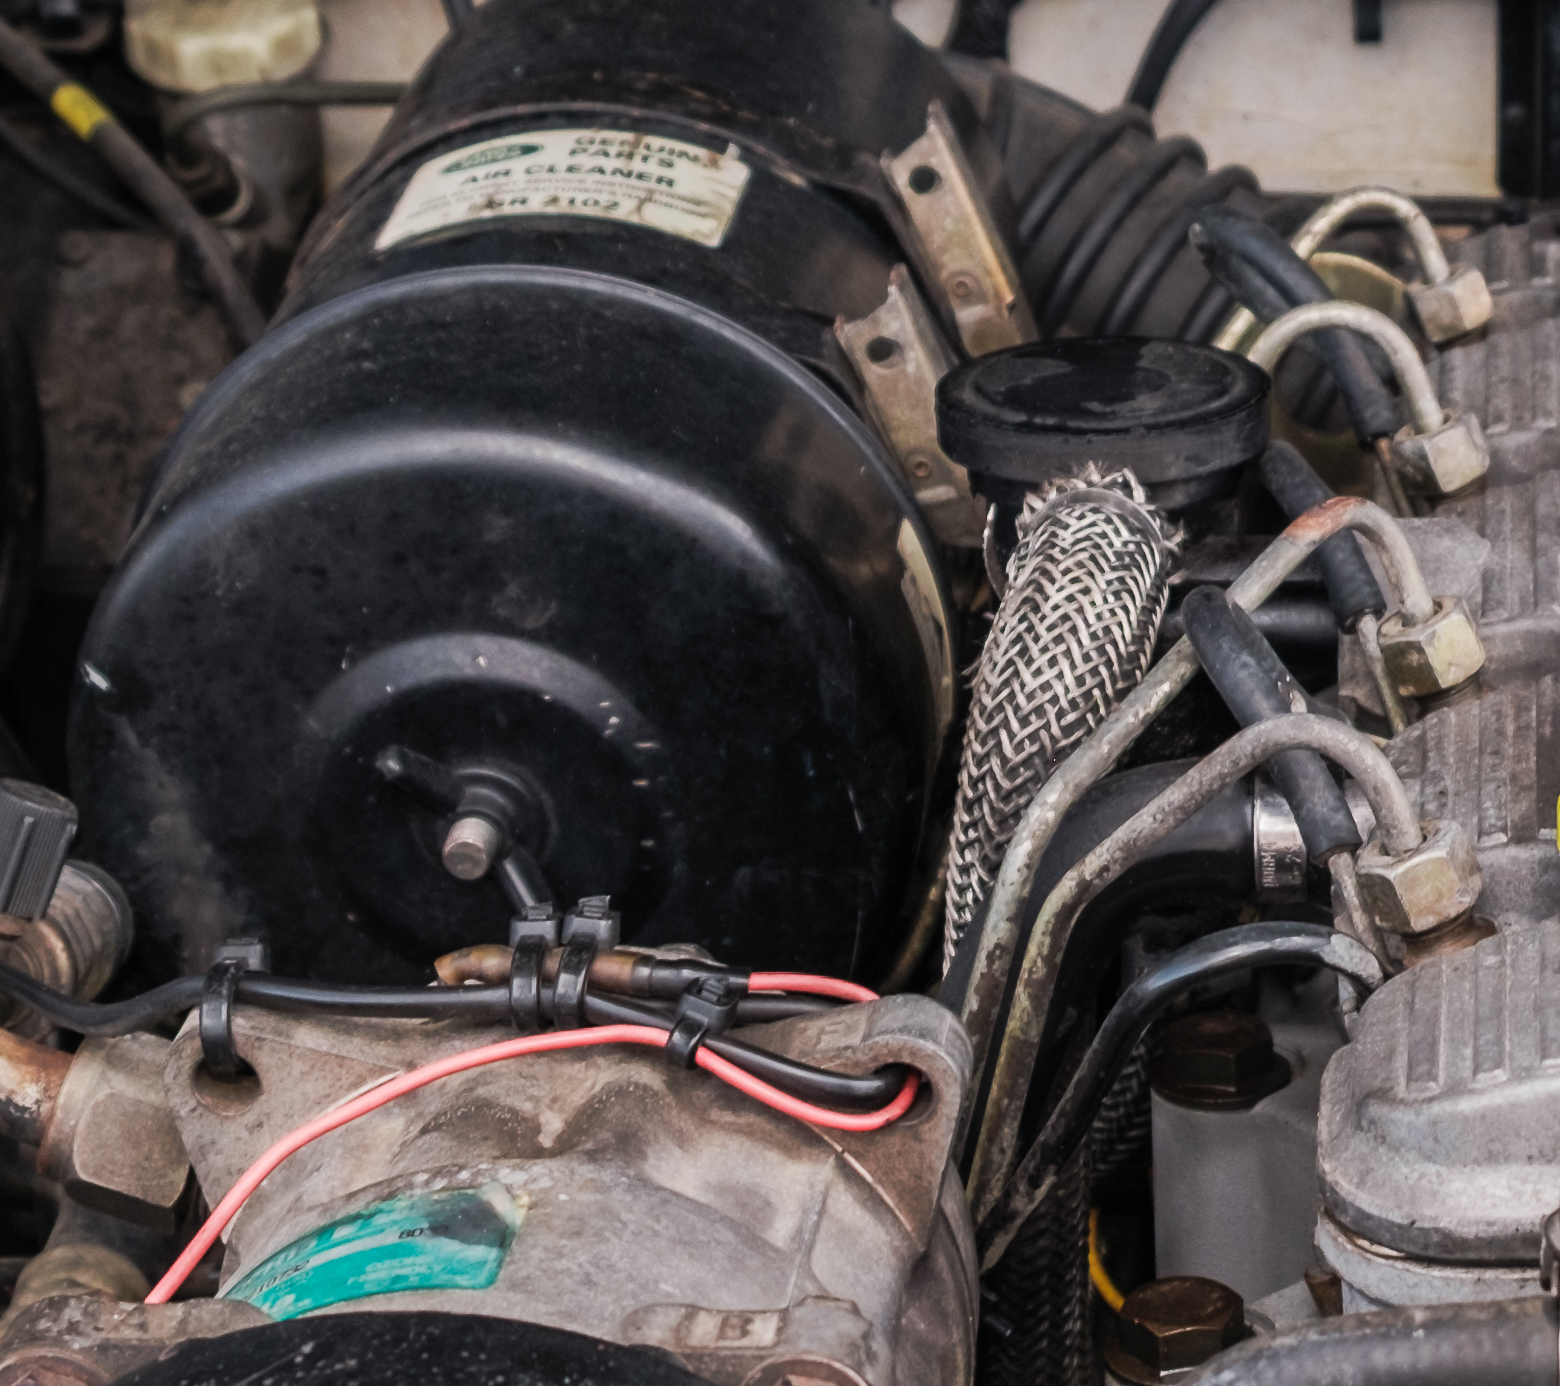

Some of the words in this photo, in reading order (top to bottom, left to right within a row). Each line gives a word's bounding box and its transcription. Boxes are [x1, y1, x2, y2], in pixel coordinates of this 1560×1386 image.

[575, 136, 722, 170] GENUIN
[460, 168, 513, 186] AIR
[524, 164, 677, 188] CLEANER
